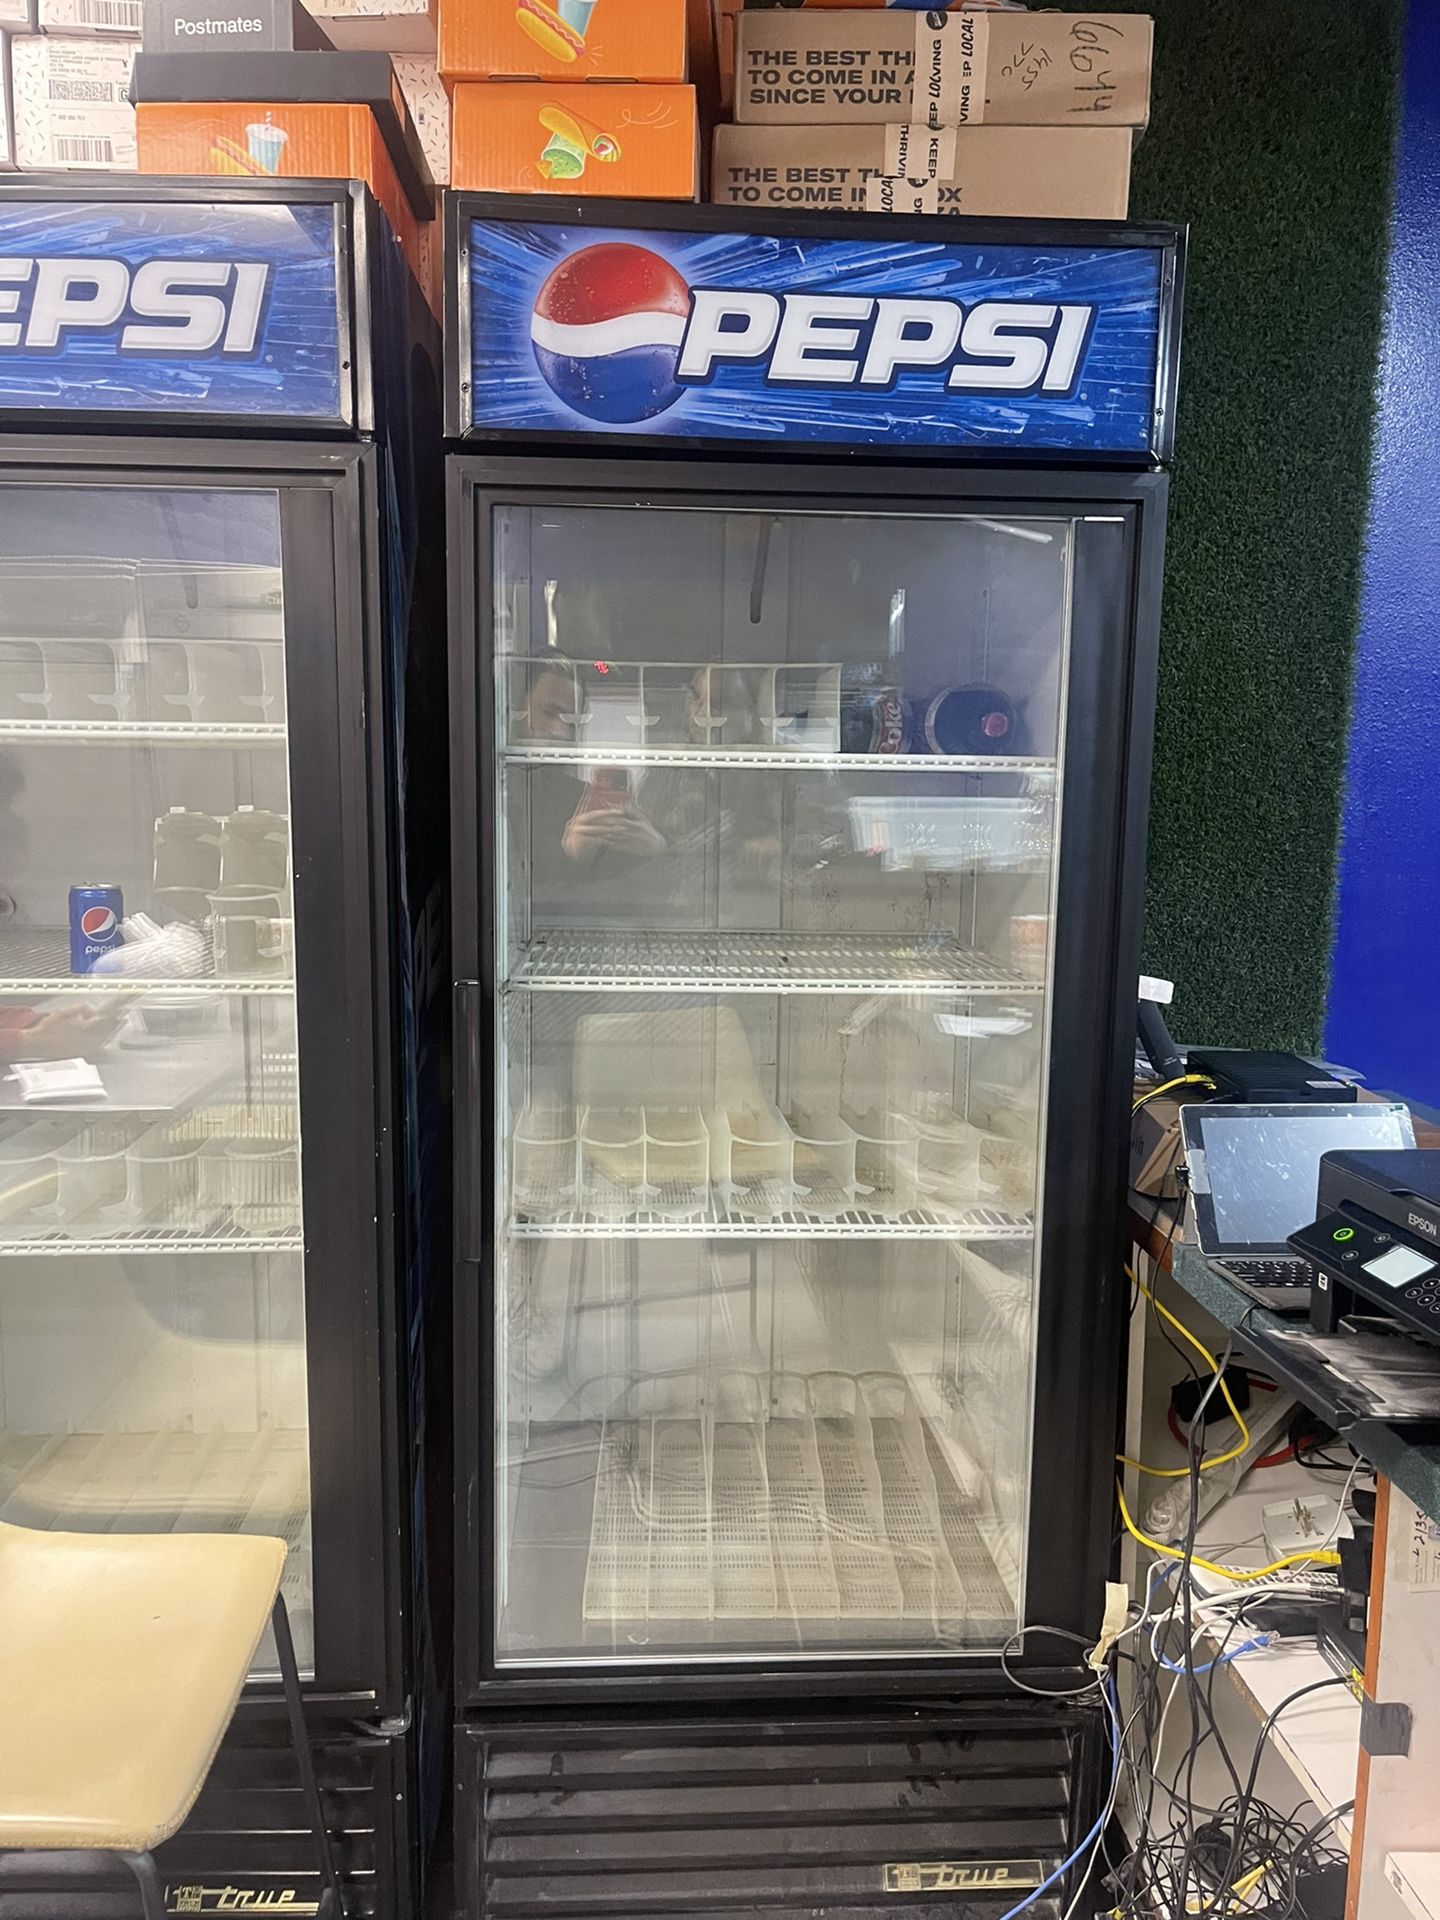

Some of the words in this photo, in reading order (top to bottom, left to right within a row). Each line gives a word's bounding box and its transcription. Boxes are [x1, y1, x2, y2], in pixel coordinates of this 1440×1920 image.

[174, 16, 263, 36] Postmates
[961, 18, 974, 57] LOCAL
[748, 51, 797, 66] THE
[806, 51, 871, 66] BEST
[748, 70, 781, 85] TO
[788, 70, 863, 85] COME
[872, 70, 896, 85] IN
[750, 89, 826, 104] SINCE
[833, 89, 902, 104] YOUR
[928, 138, 939, 179] KEEP
[728, 168, 777, 183] THE
[786, 168, 850, 183] BEST
[728, 187, 761, 202] TO
[768, 187, 842, 202] COME
[676, 288, 1093, 392] PEPSI
[1408, 1212, 1437, 1236] EPSON
